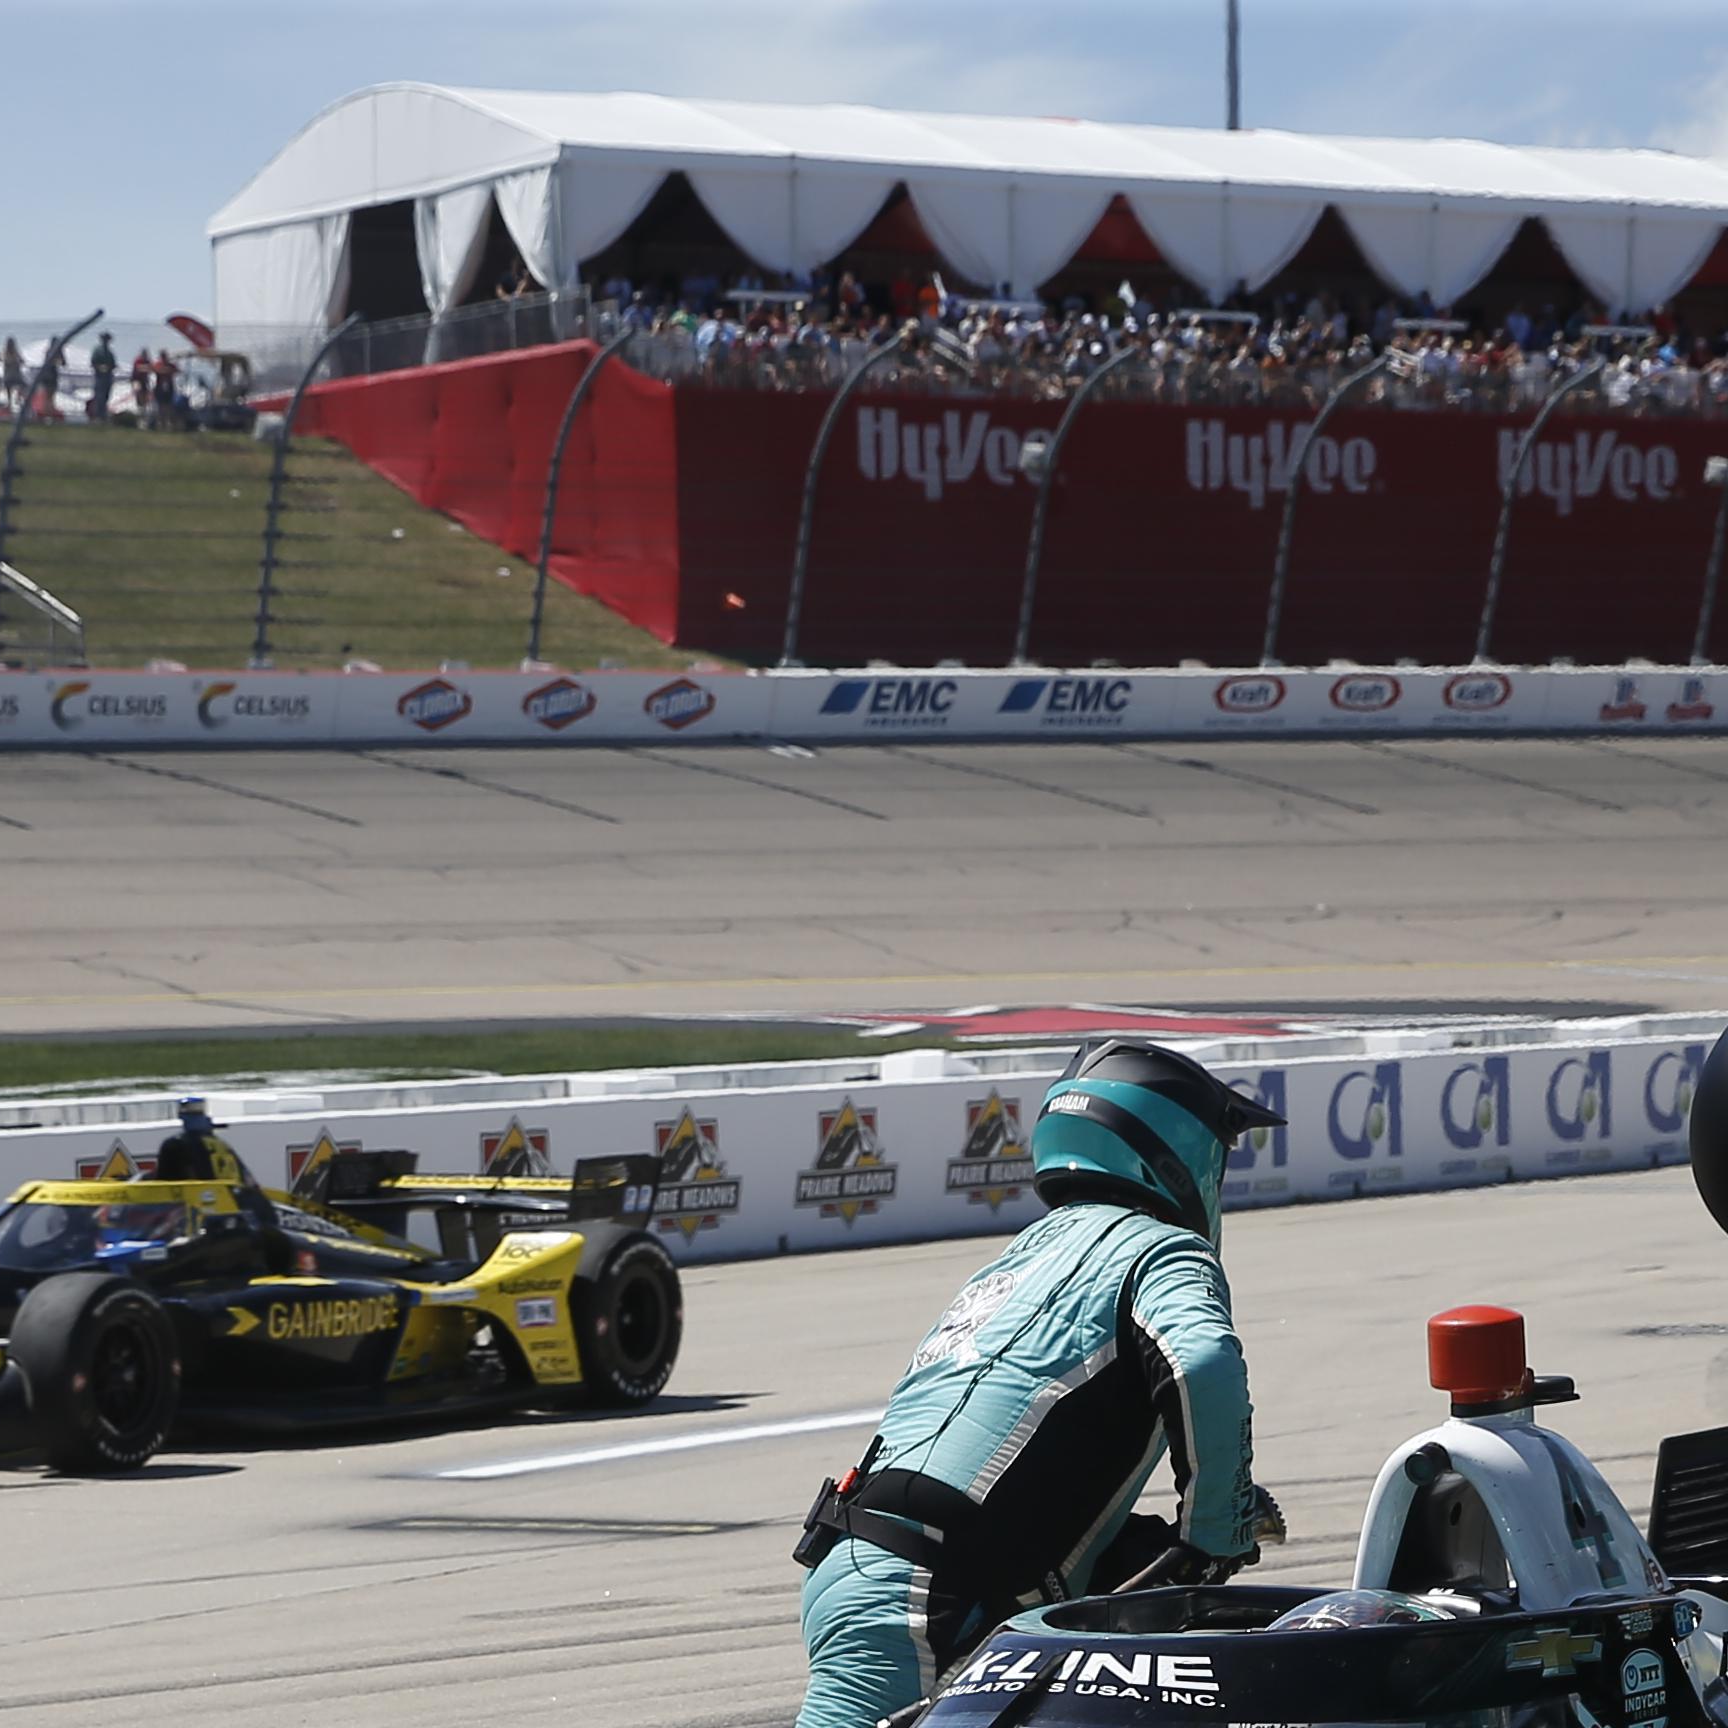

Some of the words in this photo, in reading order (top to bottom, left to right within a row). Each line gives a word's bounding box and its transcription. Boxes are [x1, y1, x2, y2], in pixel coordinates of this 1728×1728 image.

[88, 694, 167, 716] CELSIUS
[233, 694, 310, 716] CELSIUS
[869, 679, 958, 713] EMC
[1045, 679, 1132, 713] EMC
[1048, 1094, 1091, 1114] GRAHAM
[680, 1184, 737, 1210] MEADOWS
[800, 1175, 841, 1200] PRAIRIE
[842, 1171, 894, 1196] MEADOWS
[268, 1292, 402, 1339] GAINBRIDGE
[953, 1649, 1221, 1693] K-LINE
[1639, 1663, 1661, 1685] NTT
[1074, 1682, 1150, 1702] USA,
[1160, 1689, 1227, 1709] INC.
[1624, 1689, 1667, 1714] INDYCAR
[1633, 1706, 1660, 1721] SERIES
